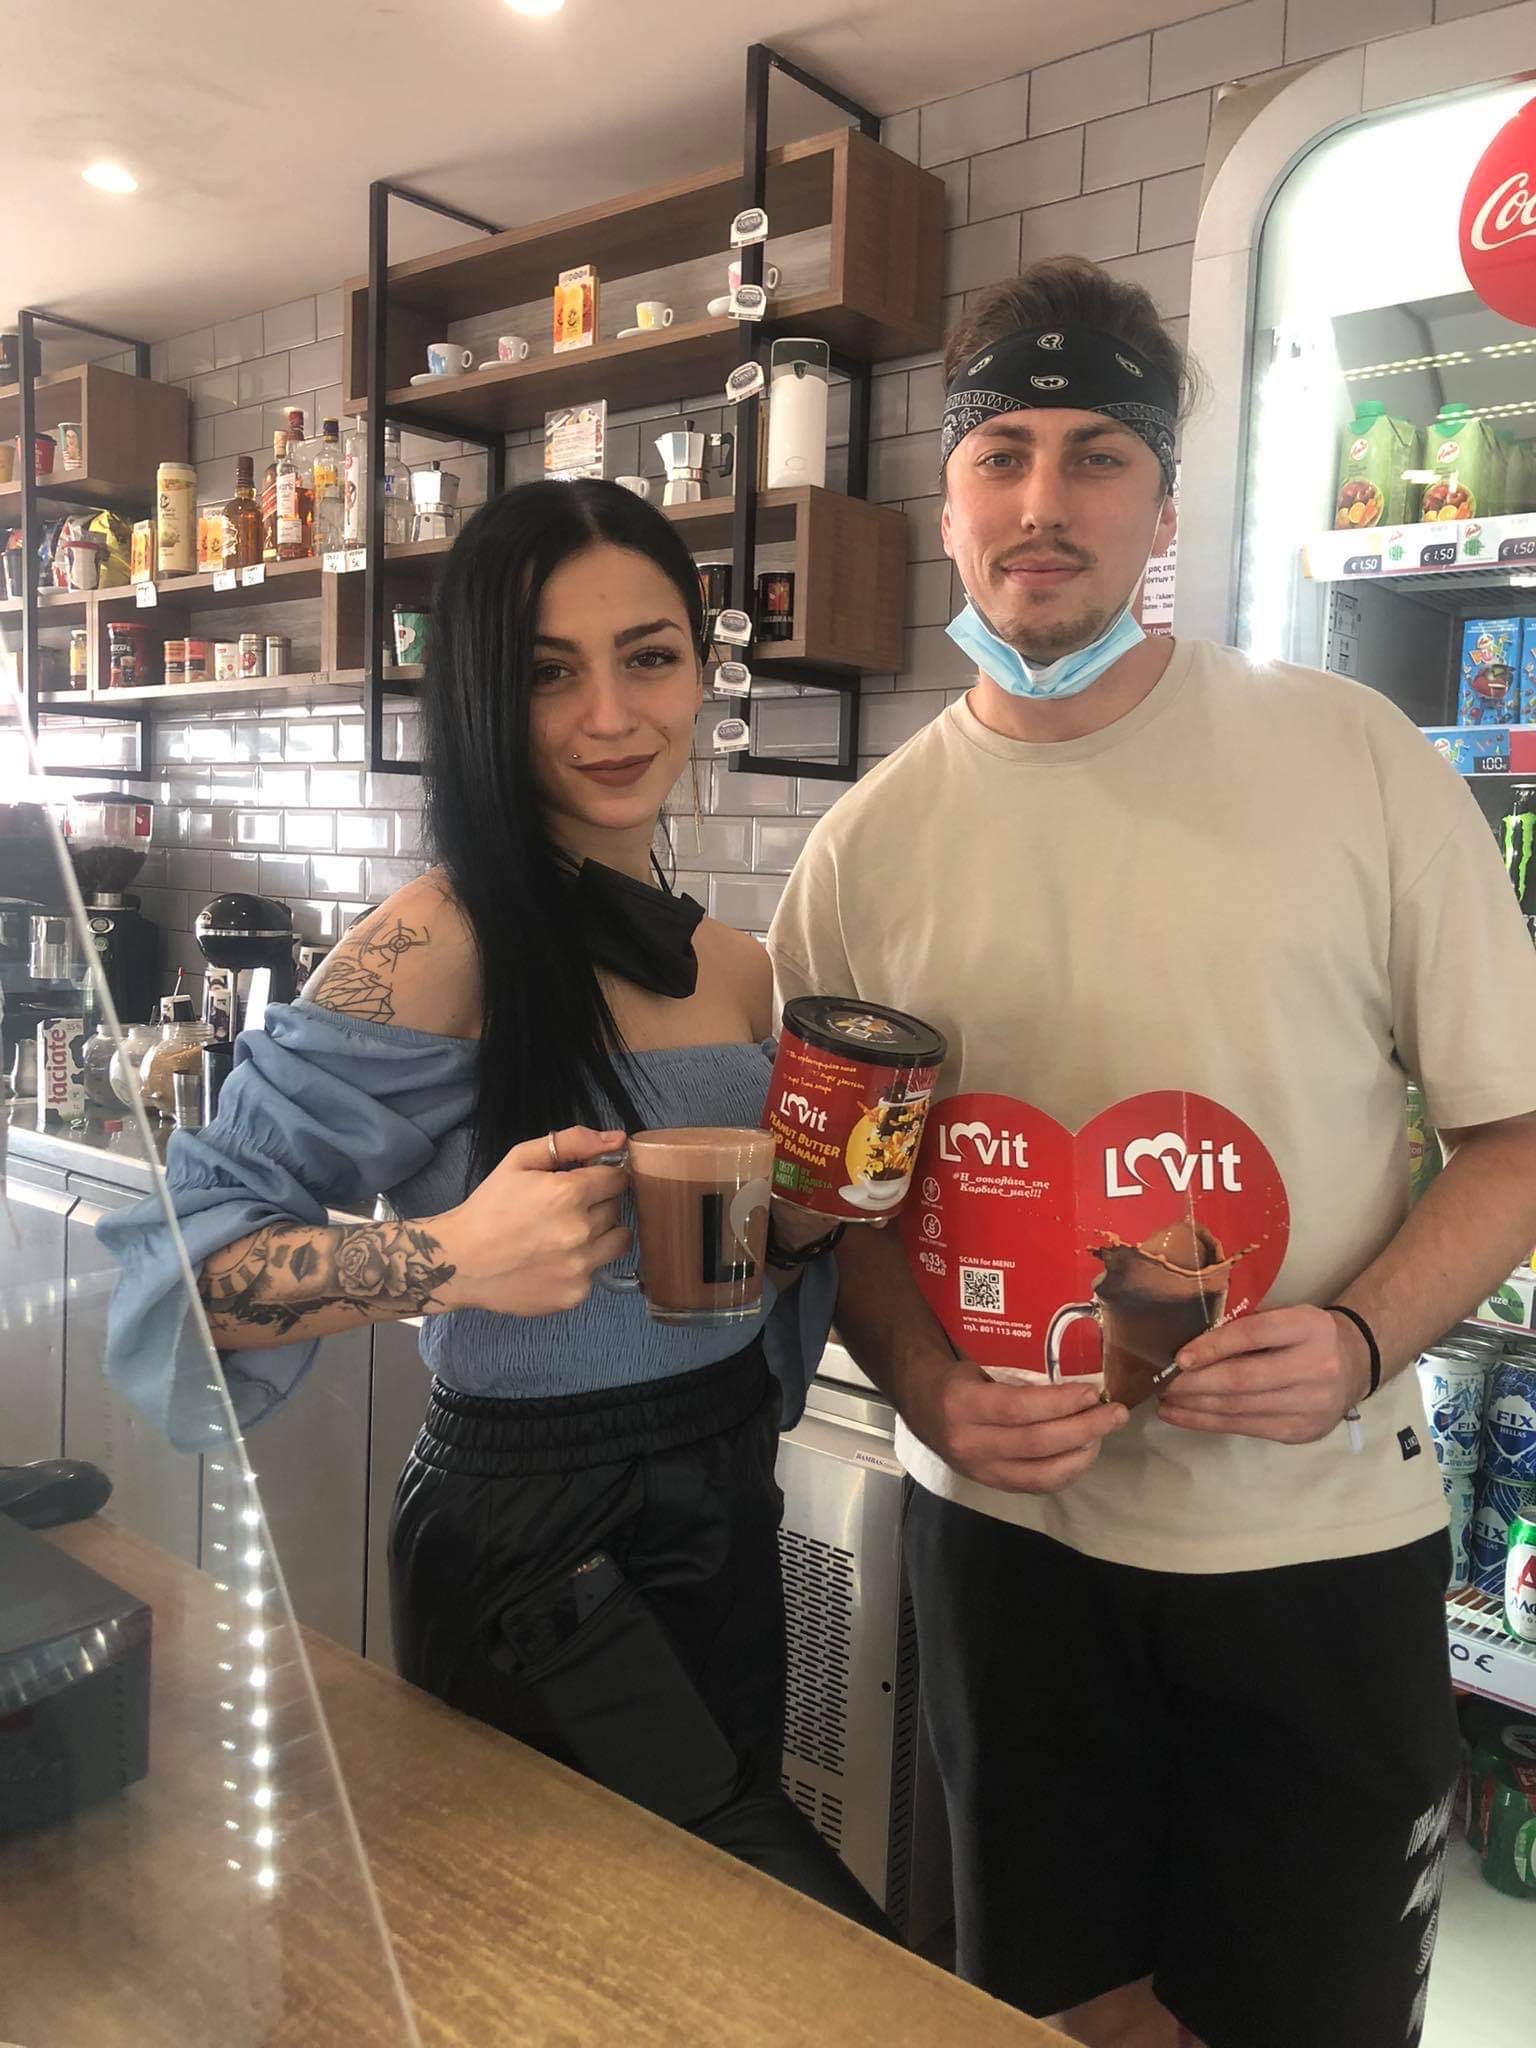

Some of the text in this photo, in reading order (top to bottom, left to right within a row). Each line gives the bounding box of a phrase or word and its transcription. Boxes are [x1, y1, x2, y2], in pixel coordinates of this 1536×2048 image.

[769, 1111, 841, 1158] PEANUT BUTTER
[784, 1141, 827, 1168] BANANA
[959, 1255, 1016, 1269] SCAN for MENU
[1496, 1409, 1534, 1429] FIX
[1500, 1426, 1527, 1439] HELLAS
[1475, 1521, 1506, 1543] FIX
